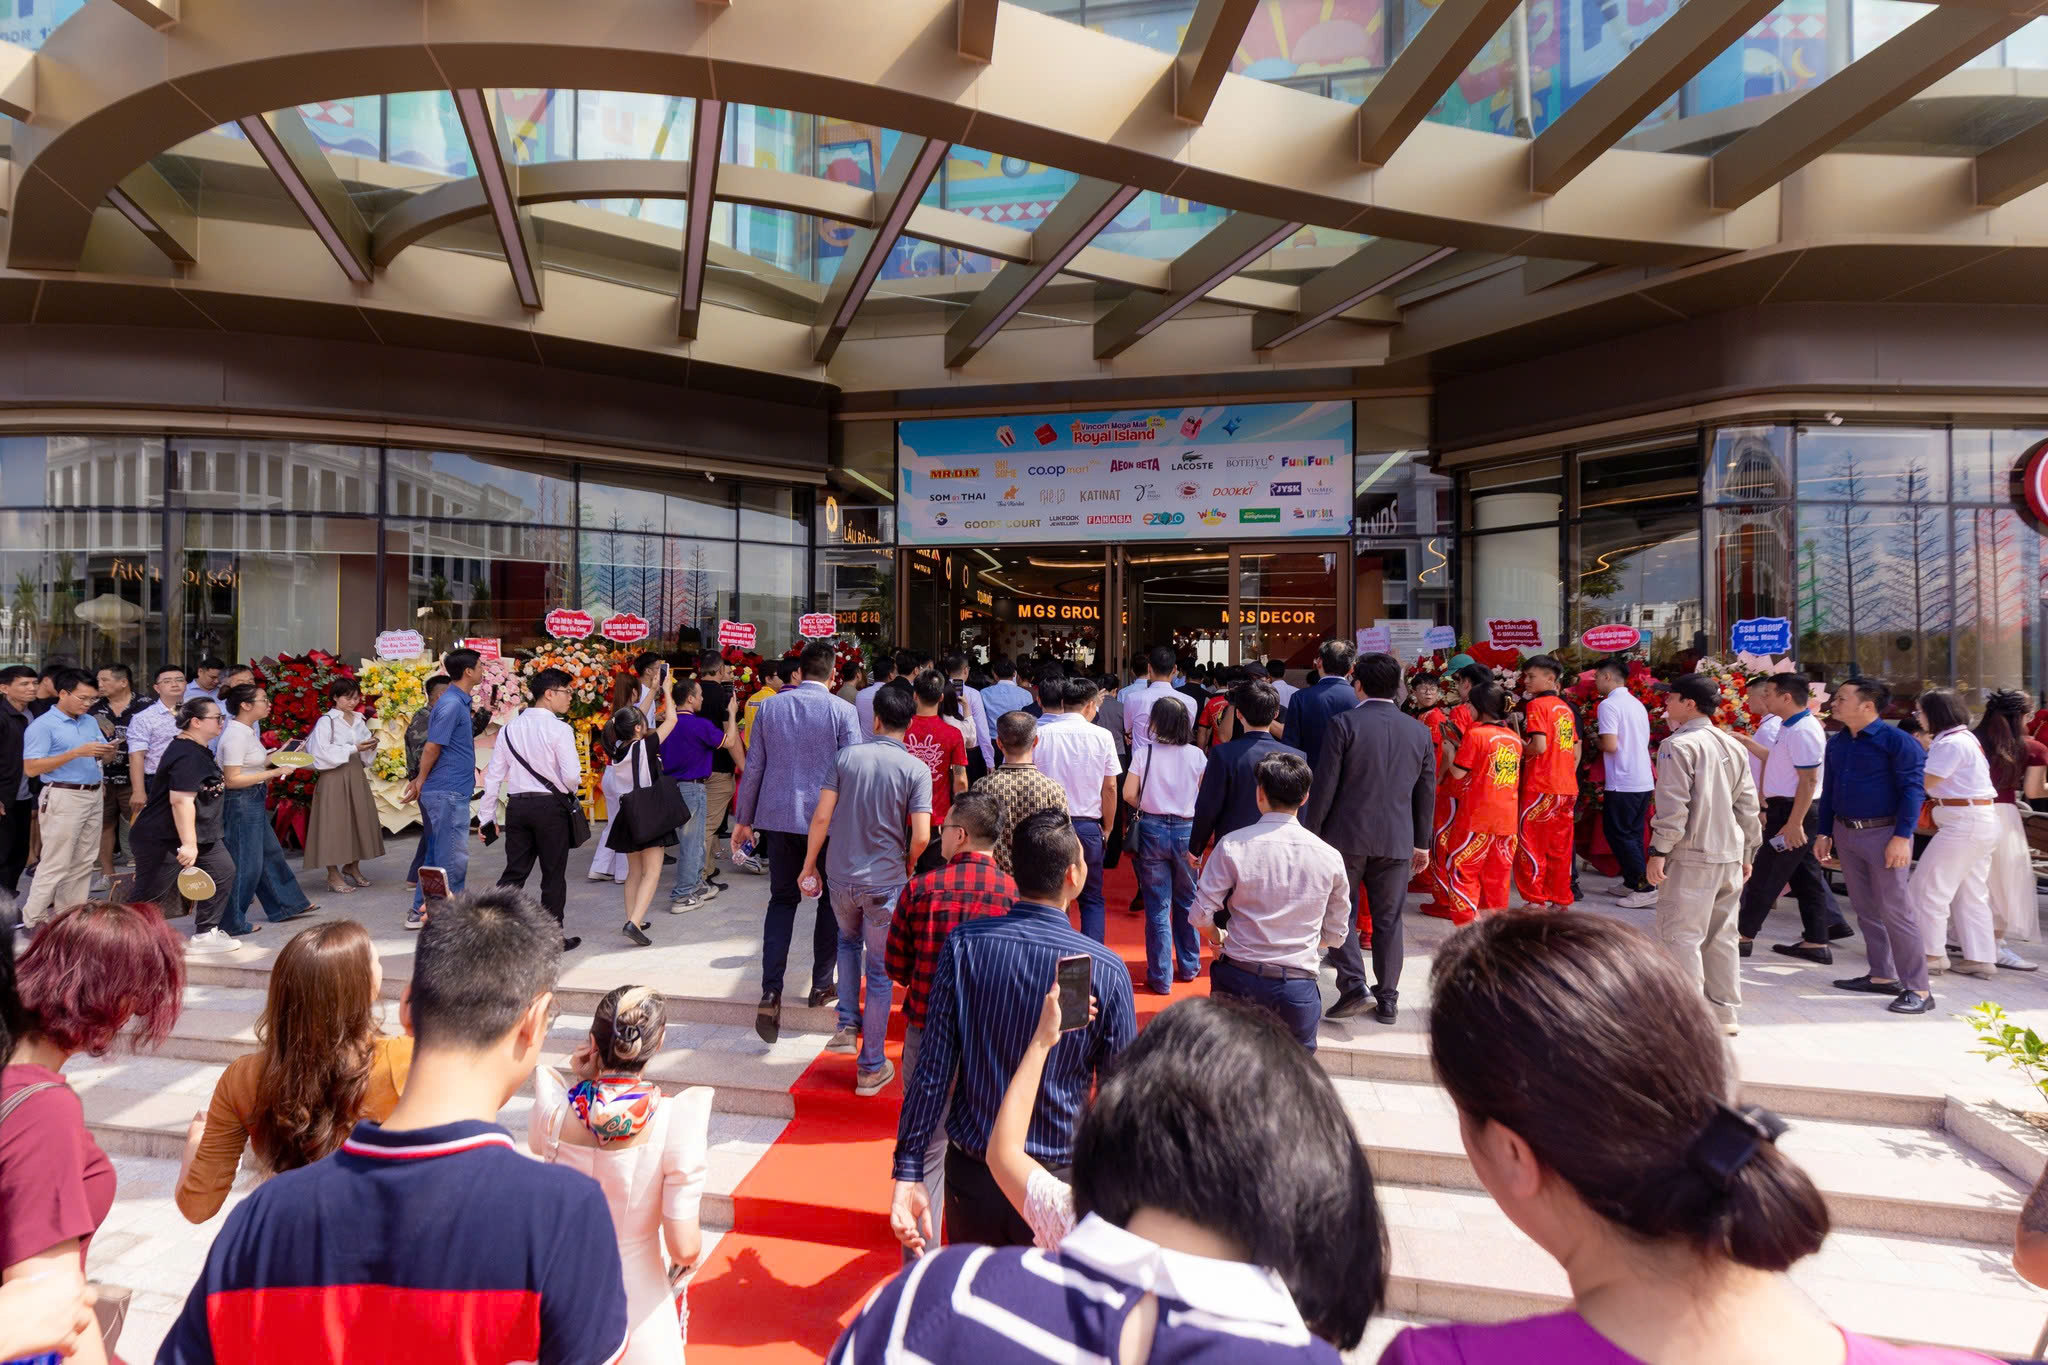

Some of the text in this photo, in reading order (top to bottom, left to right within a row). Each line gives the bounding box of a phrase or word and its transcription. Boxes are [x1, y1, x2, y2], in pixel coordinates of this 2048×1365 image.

[1081, 423, 1110, 431] Vincom
[1111, 422, 1131, 430] Mega
[1073, 428, 1155, 446] Royal Island
[1110, 459, 1133, 472] AEON
[1136, 457, 1160, 471] BETA
[1171, 462, 1214, 471] LACOSTE
[1213, 487, 1253, 496] DOOKKI
[1276, 484, 1300, 493] JYSK
[929, 494, 951, 502] SOM
[961, 492, 986, 501] THAI
[1080, 489, 1120, 502] KATINAT
[1087, 515, 1132, 525] FAHASA
[1018, 604, 1056, 619] MGS
[1260, 611, 1315, 624] DECOR
[1739, 624, 1782, 633] SSM GROUP
